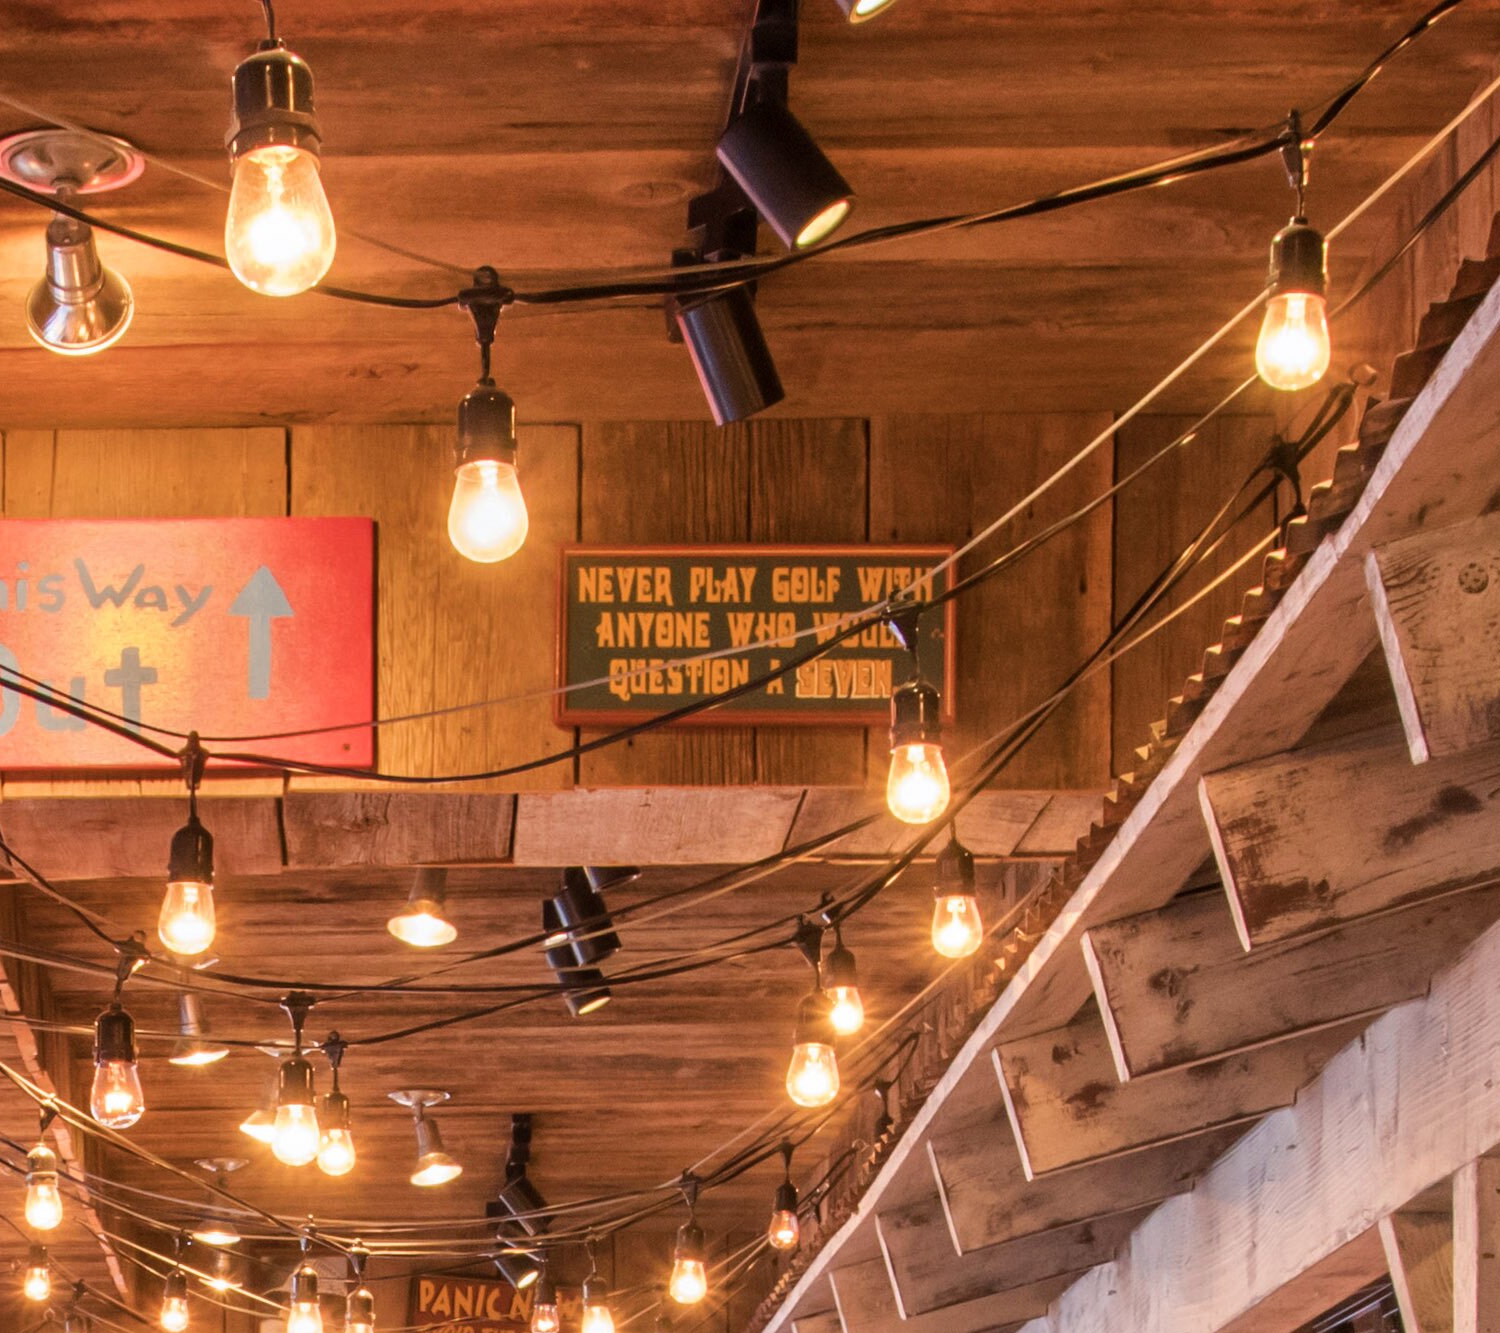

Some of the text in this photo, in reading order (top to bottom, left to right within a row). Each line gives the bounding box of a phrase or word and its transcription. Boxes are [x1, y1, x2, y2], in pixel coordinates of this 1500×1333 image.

[74, 558, 214, 628] Way
[578, 567, 934, 605] NEVER PLAY GOLF WITH
[595, 612, 909, 648] ANYONE WHO WOUL
[609, 659, 784, 701] QUESTION A
[419, 1280, 500, 1320] PANIC
